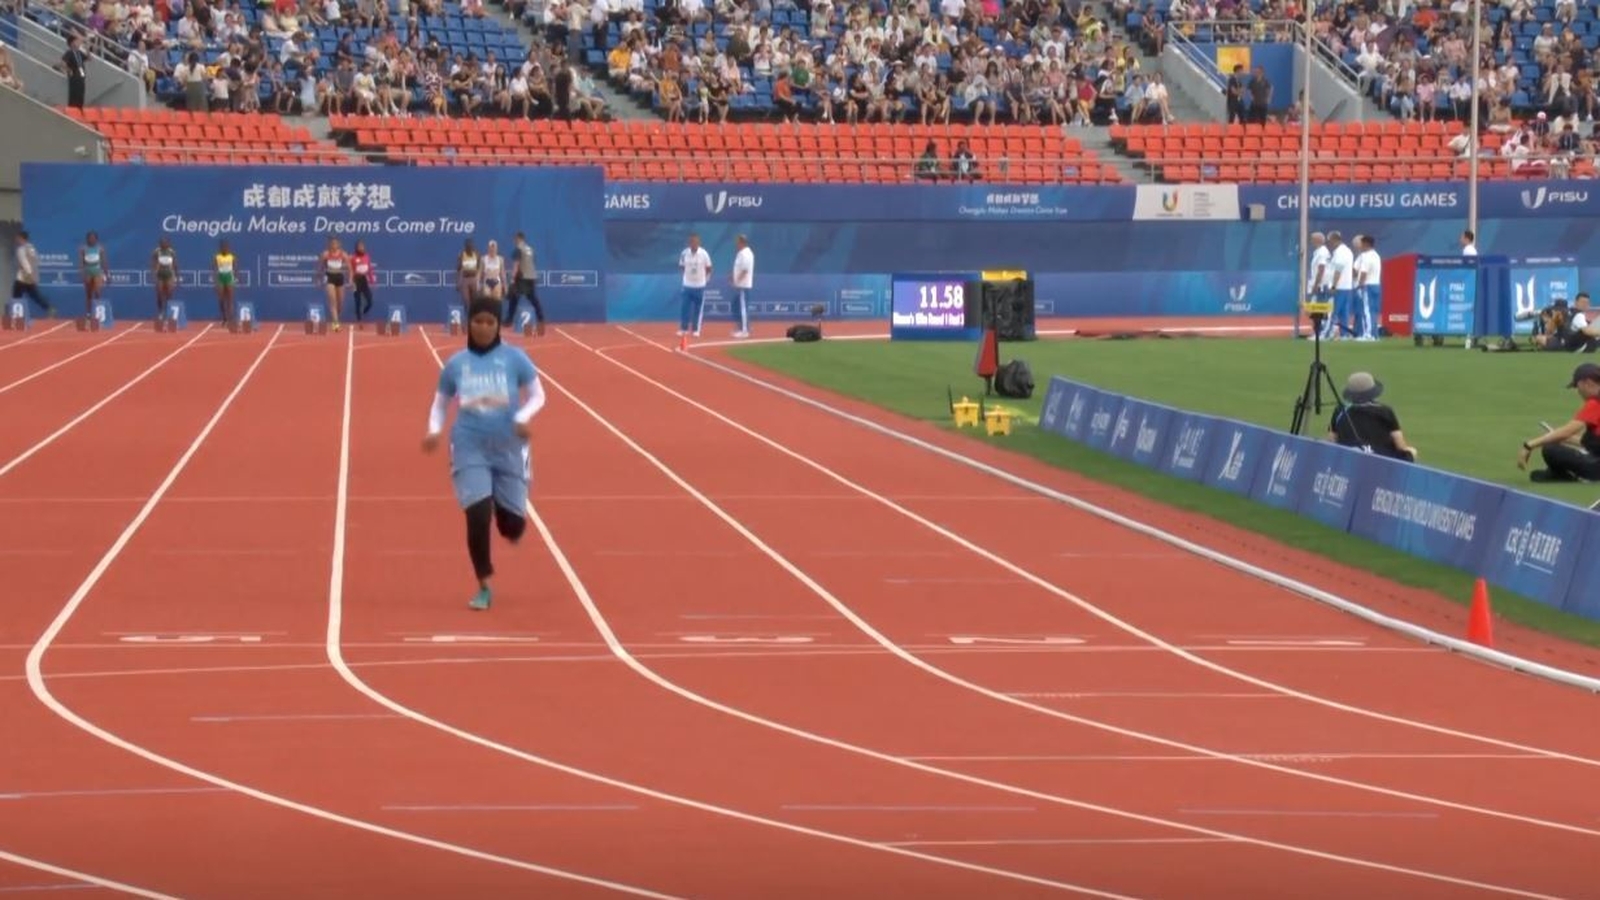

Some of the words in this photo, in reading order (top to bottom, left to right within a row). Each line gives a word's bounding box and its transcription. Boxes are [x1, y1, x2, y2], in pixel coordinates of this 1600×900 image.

[243, 183, 395, 212] 成都成就梦想
[728, 196, 763, 208] FISU
[1277, 195, 1355, 209] CHNGDU
[1360, 193, 1395, 208] FISU
[1401, 193, 1457, 207] GAMES
[1548, 190, 1588, 202] FISU
[162, 214, 242, 237] Chengdu
[247, 214, 307, 233] Makes
[314, 216, 380, 233] Dreams
[385, 216, 436, 233] Come
[439, 217, 475, 233] True
[920, 285, 964, 309] 11.58
[95, 305, 106, 322] 8
[170, 306, 180, 321] 7
[239, 306, 250, 322] 6
[309, 308, 320, 323] 5
[390, 309, 401, 323] 4
[451, 309, 461, 324] 3
